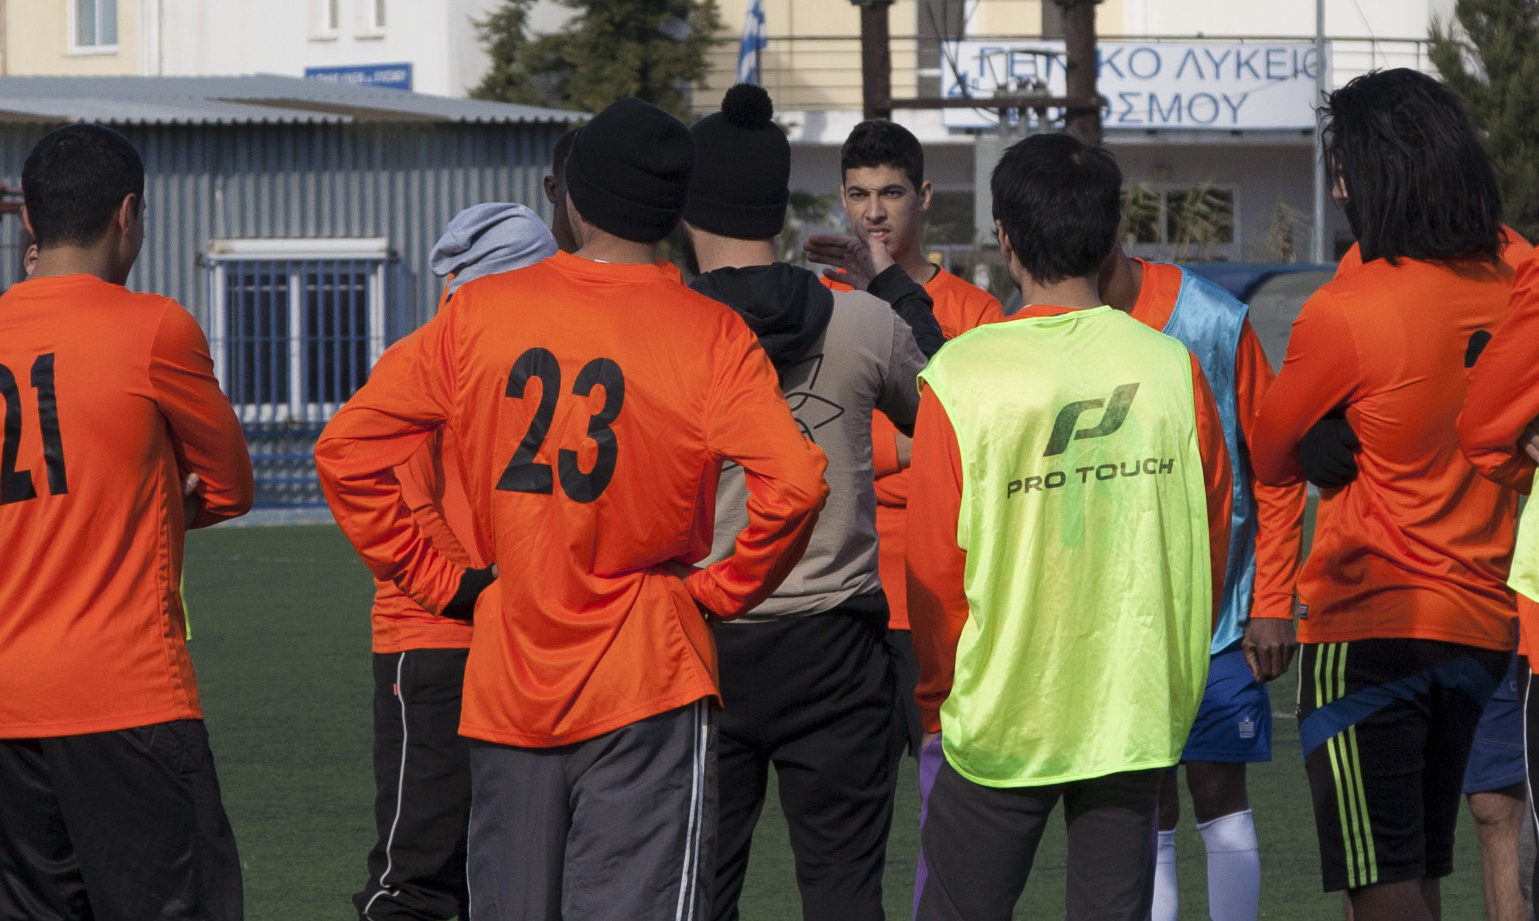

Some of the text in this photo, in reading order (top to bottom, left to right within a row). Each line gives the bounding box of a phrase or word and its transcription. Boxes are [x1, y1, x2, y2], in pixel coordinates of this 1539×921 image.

[979, 46, 1162, 80] ΓΕΝΚΟ
[1058, 92, 1250, 124] ΣΜΟΥ
[495, 347, 626, 504] 23
[1007, 457, 1175, 499] PRO TOUCH
